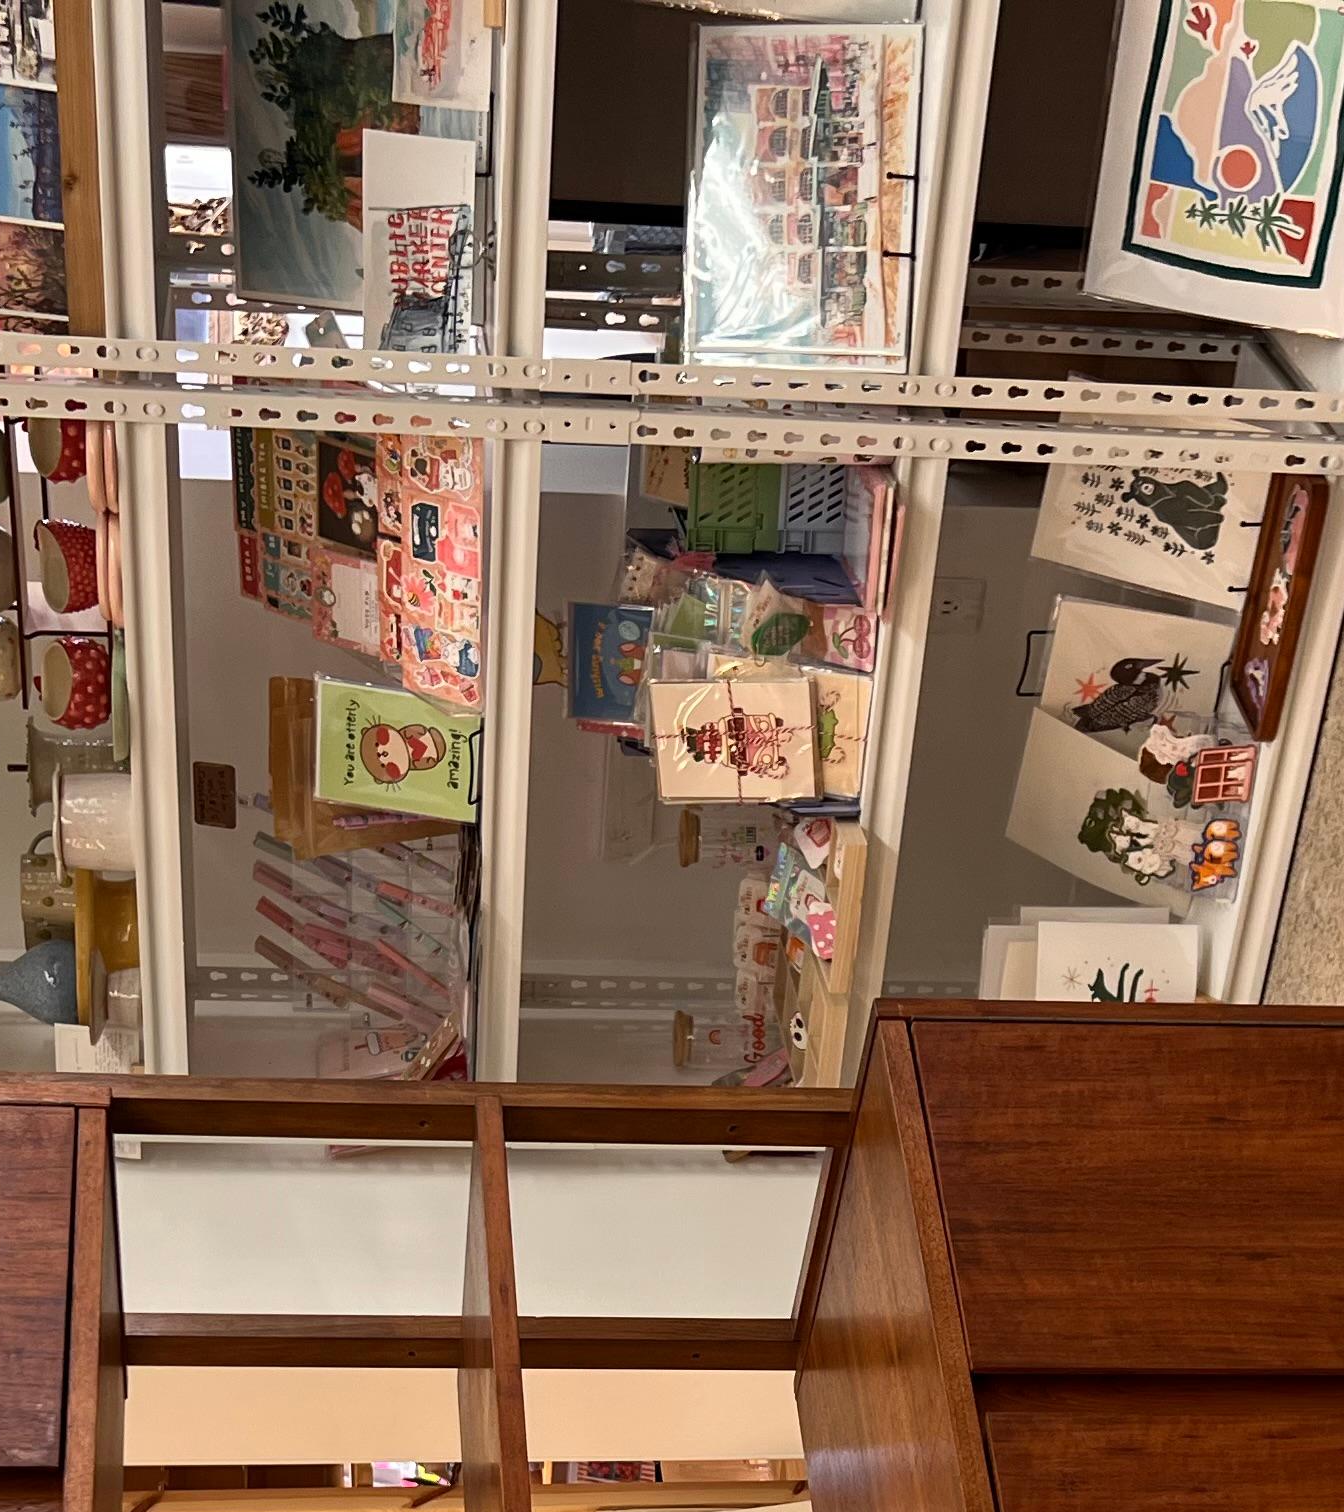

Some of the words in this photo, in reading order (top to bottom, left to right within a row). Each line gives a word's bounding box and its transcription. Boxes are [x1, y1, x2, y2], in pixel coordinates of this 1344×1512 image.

[387, 213, 409, 309] PUBLIC
[429, 207, 454, 294] CENTER
[345, 699, 360, 740] otterly
[343, 764, 355, 786] You
[345, 743, 355, 761] are
[447, 728, 468, 790] amazing!
[742, 1012, 766, 1064] Good
